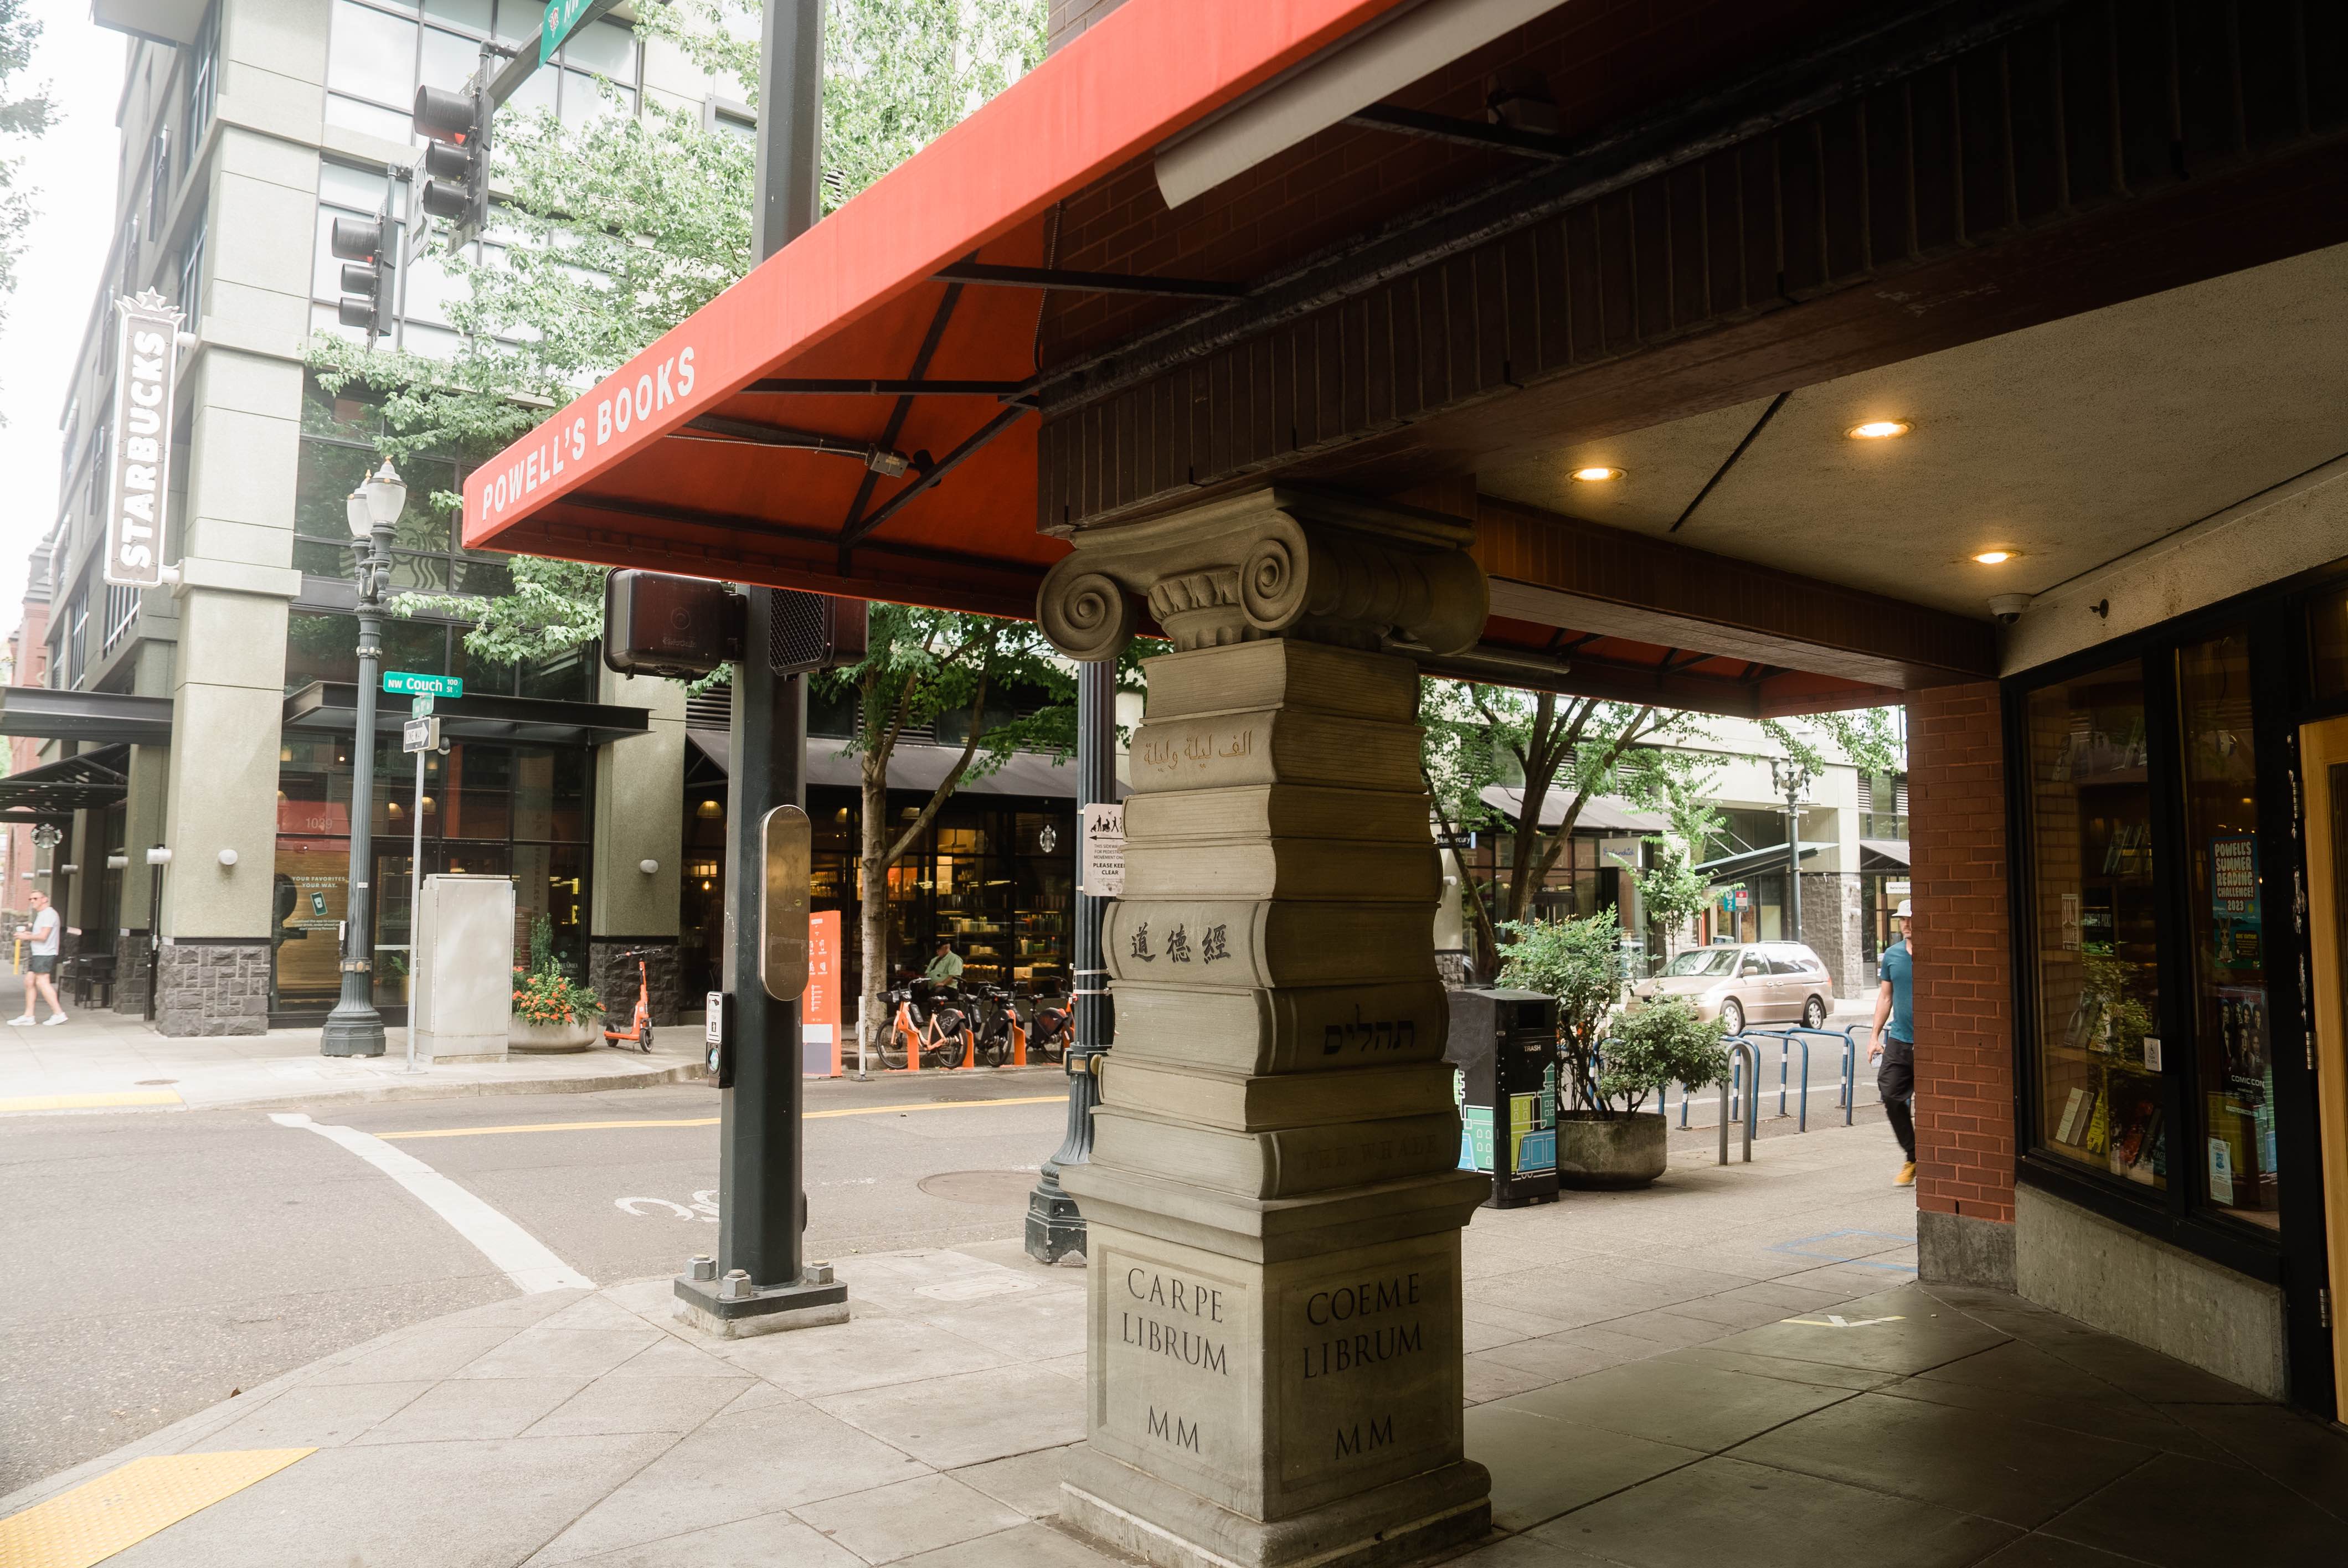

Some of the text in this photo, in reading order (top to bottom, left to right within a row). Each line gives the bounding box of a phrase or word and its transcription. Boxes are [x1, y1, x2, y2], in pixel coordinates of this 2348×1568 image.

[119, 329, 167, 571] STARBUCKS
[482, 346, 696, 521] POWELL'S BOOKS
[388, 678, 442, 692] NW Couch
[1436, 835, 1471, 845] bluercury
[2215, 841, 2252, 858] POWELL'S
[2216, 856, 2252, 872] SUMMER
[2217, 871, 2253, 887] READING
[1727, 900, 1733, 909] 2
[2217, 887, 2254, 898] CHALLENGE!
[2227, 900, 2244, 911] 2023
[1131, 921, 1232, 964] 道德經
[1324, 1003, 1415, 1055] תהלים
[2231, 1075, 2265, 1089] COMIC CON
[1360, 1133, 1438, 1164] WHALE
[1127, 1267, 1223, 1323] CARPE
[1306, 1272, 1421, 1326] COEME
[1122, 1311, 1229, 1376] LIBRUM
[1302, 1321, 1423, 1379] LIBRUM
[1147, 1404, 1201, 1454] MM
[1335, 1414, 1395, 1461] MM
